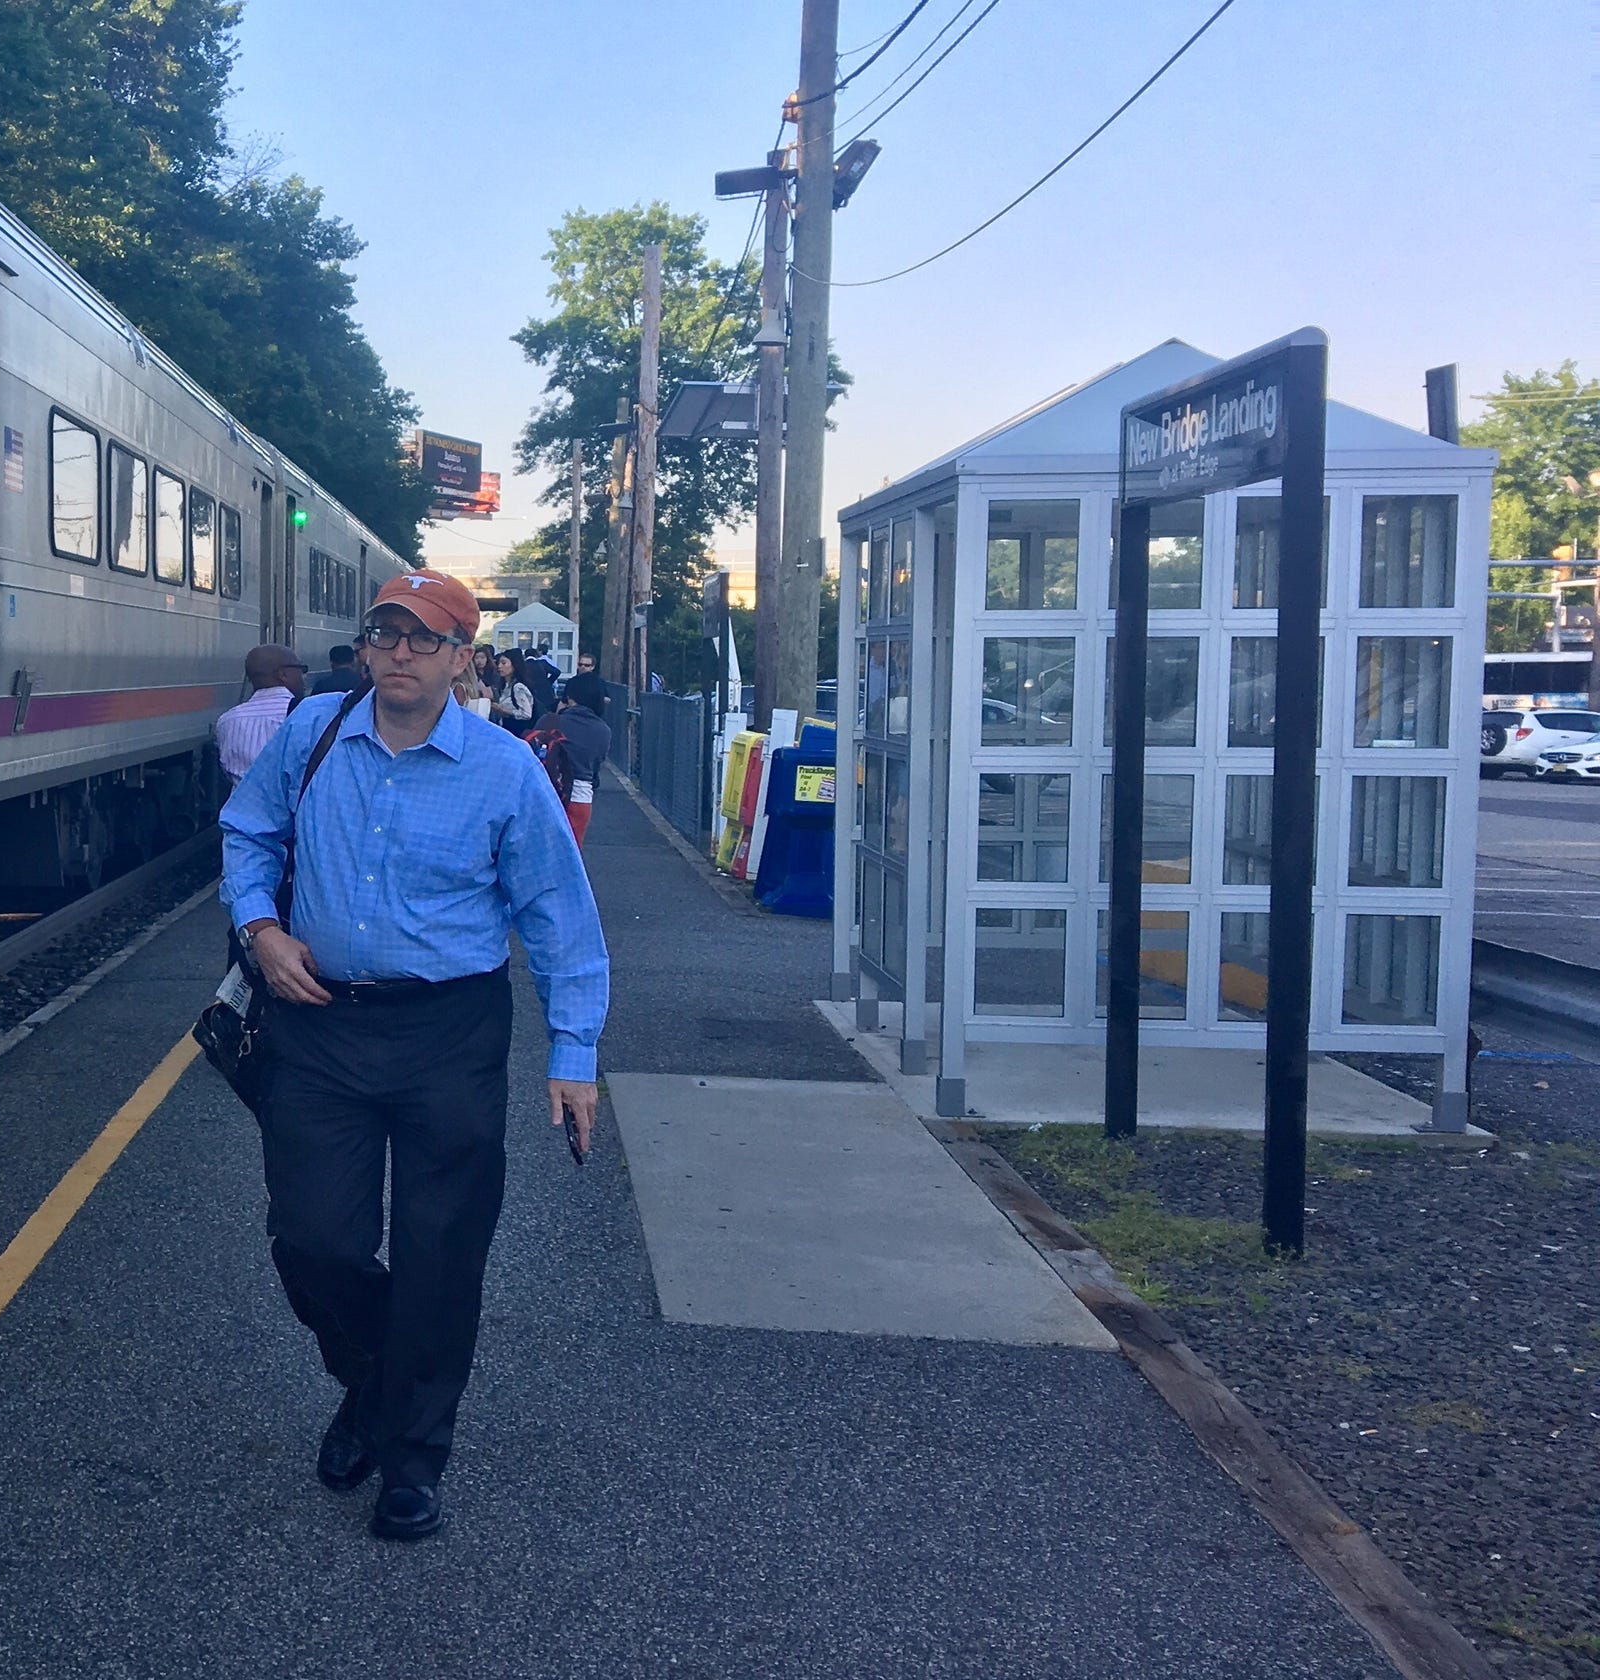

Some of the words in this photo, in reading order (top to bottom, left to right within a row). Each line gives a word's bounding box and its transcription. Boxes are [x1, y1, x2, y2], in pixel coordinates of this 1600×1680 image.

[1129, 422, 1160, 468] New
[1160, 403, 1209, 460] Bridge
[1211, 379, 1278, 442] Landing
[1180, 459, 1199, 480] River
[1200, 453, 1219, 477] Edge
